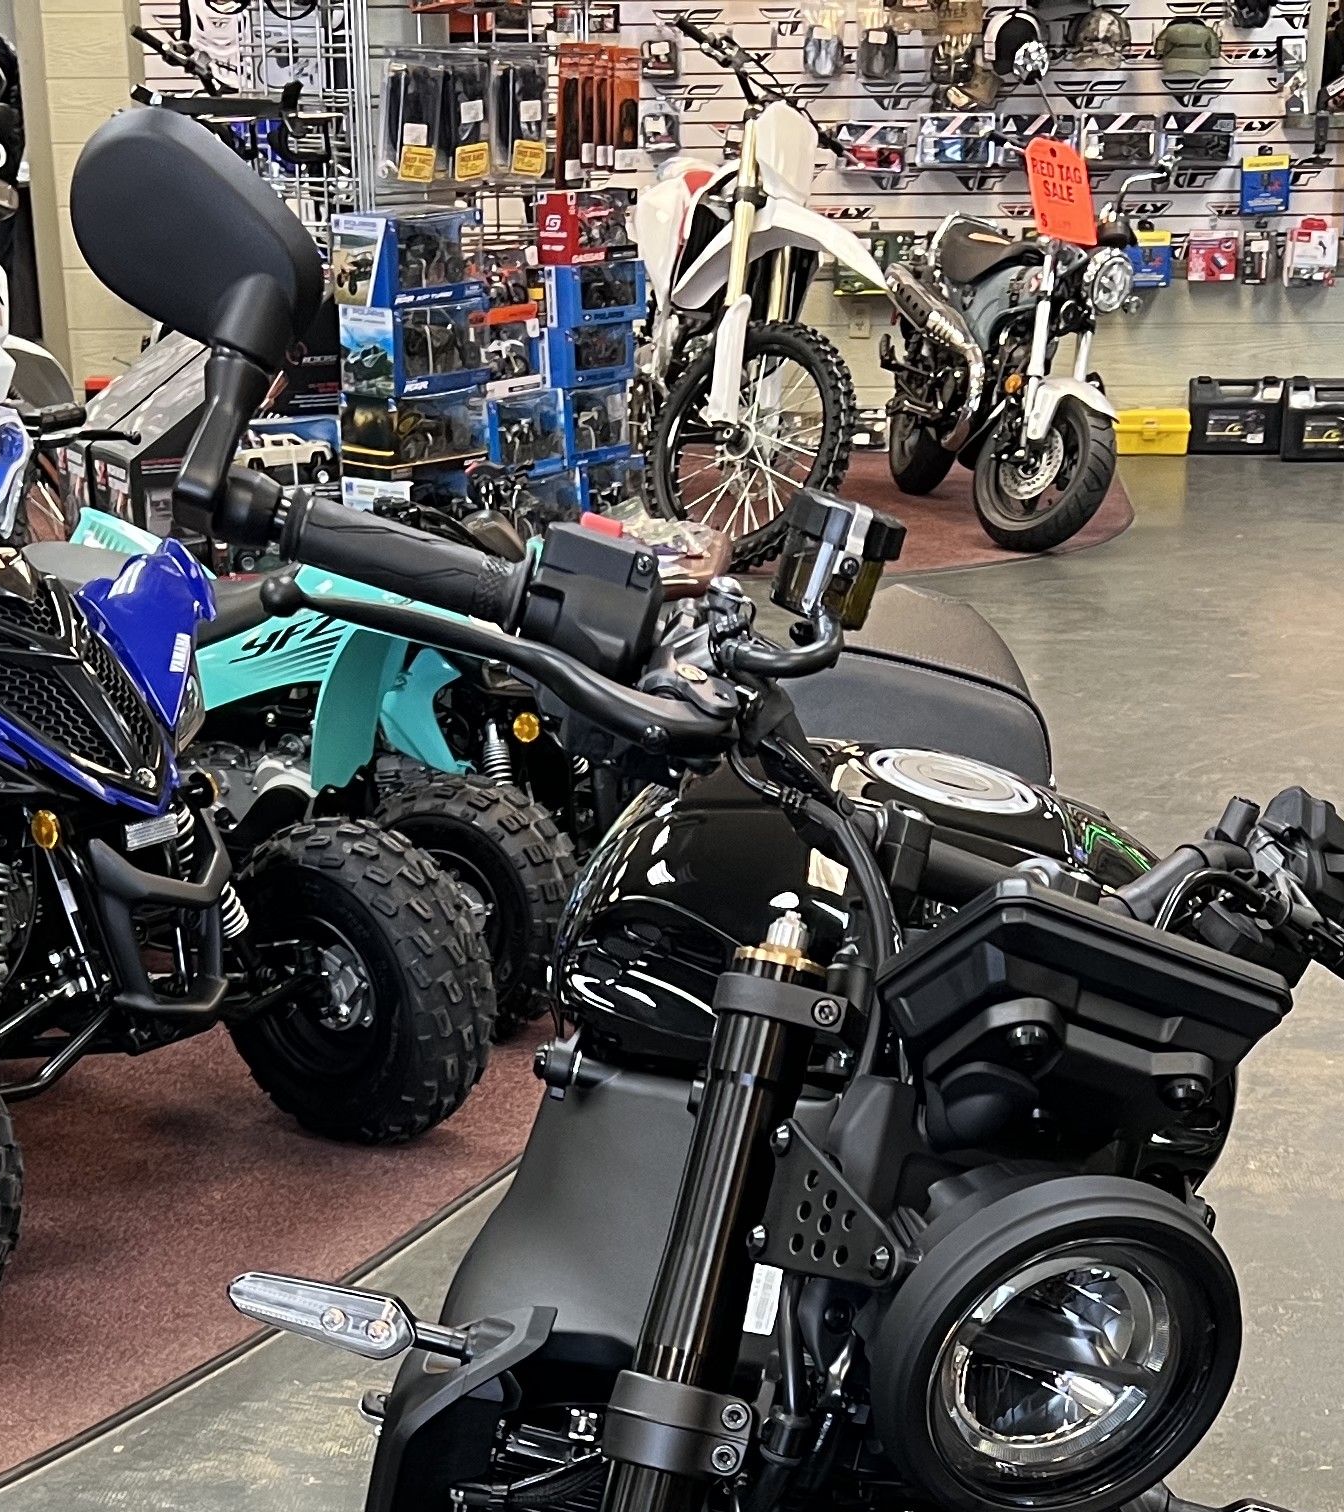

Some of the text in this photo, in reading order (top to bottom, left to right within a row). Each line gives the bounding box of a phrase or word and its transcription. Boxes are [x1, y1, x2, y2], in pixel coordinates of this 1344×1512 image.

[1031, 157, 1082, 185] RED TAG
[1043, 180, 1074, 203] SALE
